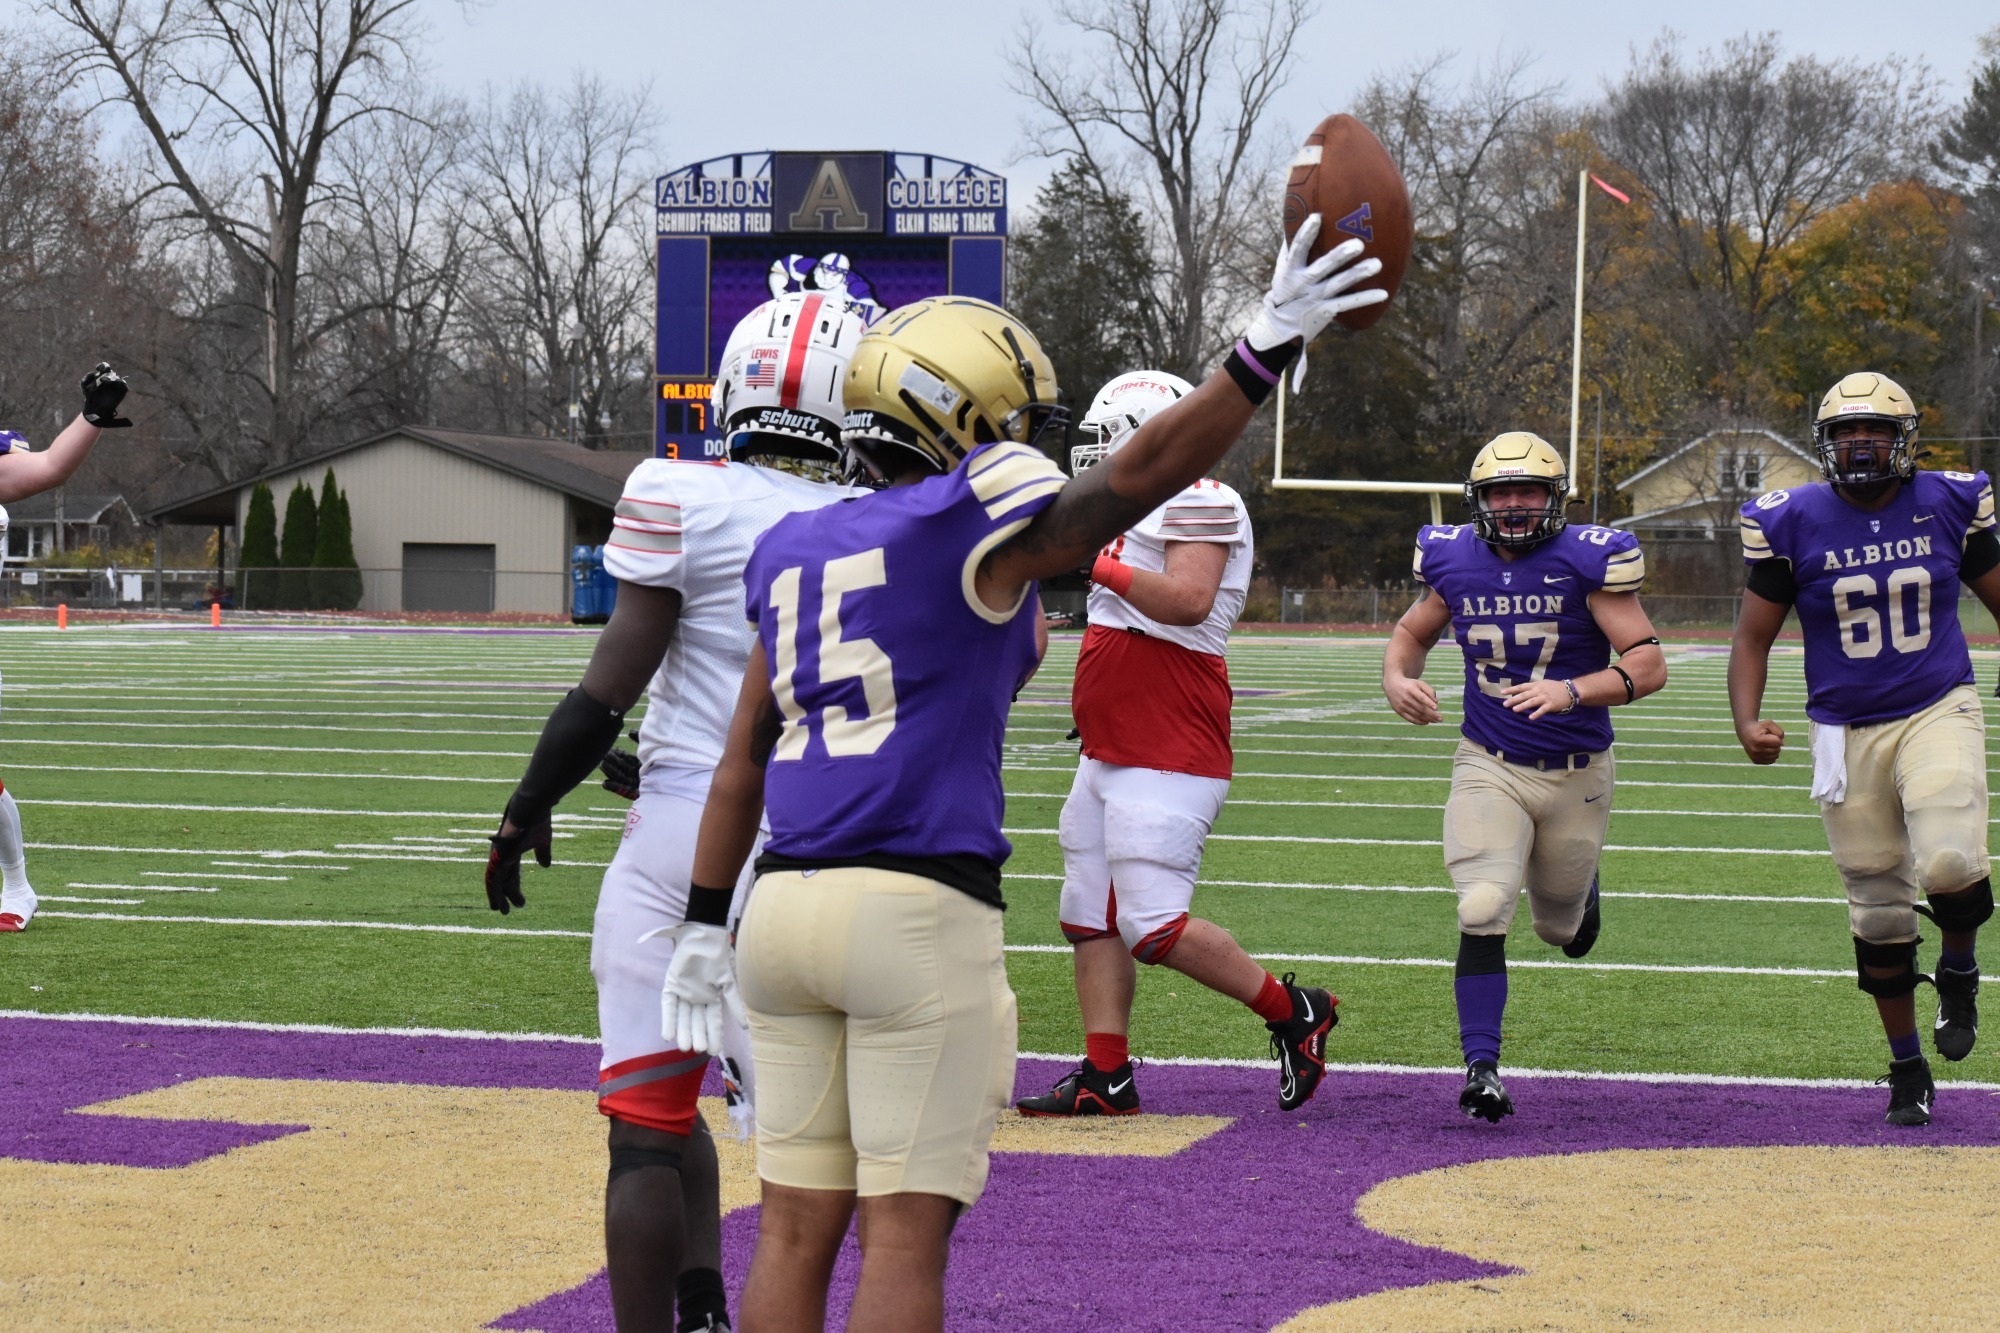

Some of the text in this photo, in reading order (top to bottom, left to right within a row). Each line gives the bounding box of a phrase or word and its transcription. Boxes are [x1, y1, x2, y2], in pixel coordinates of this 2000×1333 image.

[658, 178, 1004, 208] ALBION COLLEGE
[789, 158, 868, 231] A
[657, 212, 772, 232] SCHMIDT-FRASER FIELD
[895, 212, 996, 233] ELKIN ISAAC TRACK
[1335, 202, 1374, 242] A
[751, 348, 779, 360] LEWIS
[663, 383, 714, 399] ALBIO
[690, 403, 705, 431] 7
[704, 439, 724, 456] DO
[1823, 535, 1932, 571] ALBION
[1462, 595, 1564, 617] ALBION
[1831, 565, 1932, 659] 60
[768, 546, 898, 762] 15
[1466, 621, 1560, 700] 27
